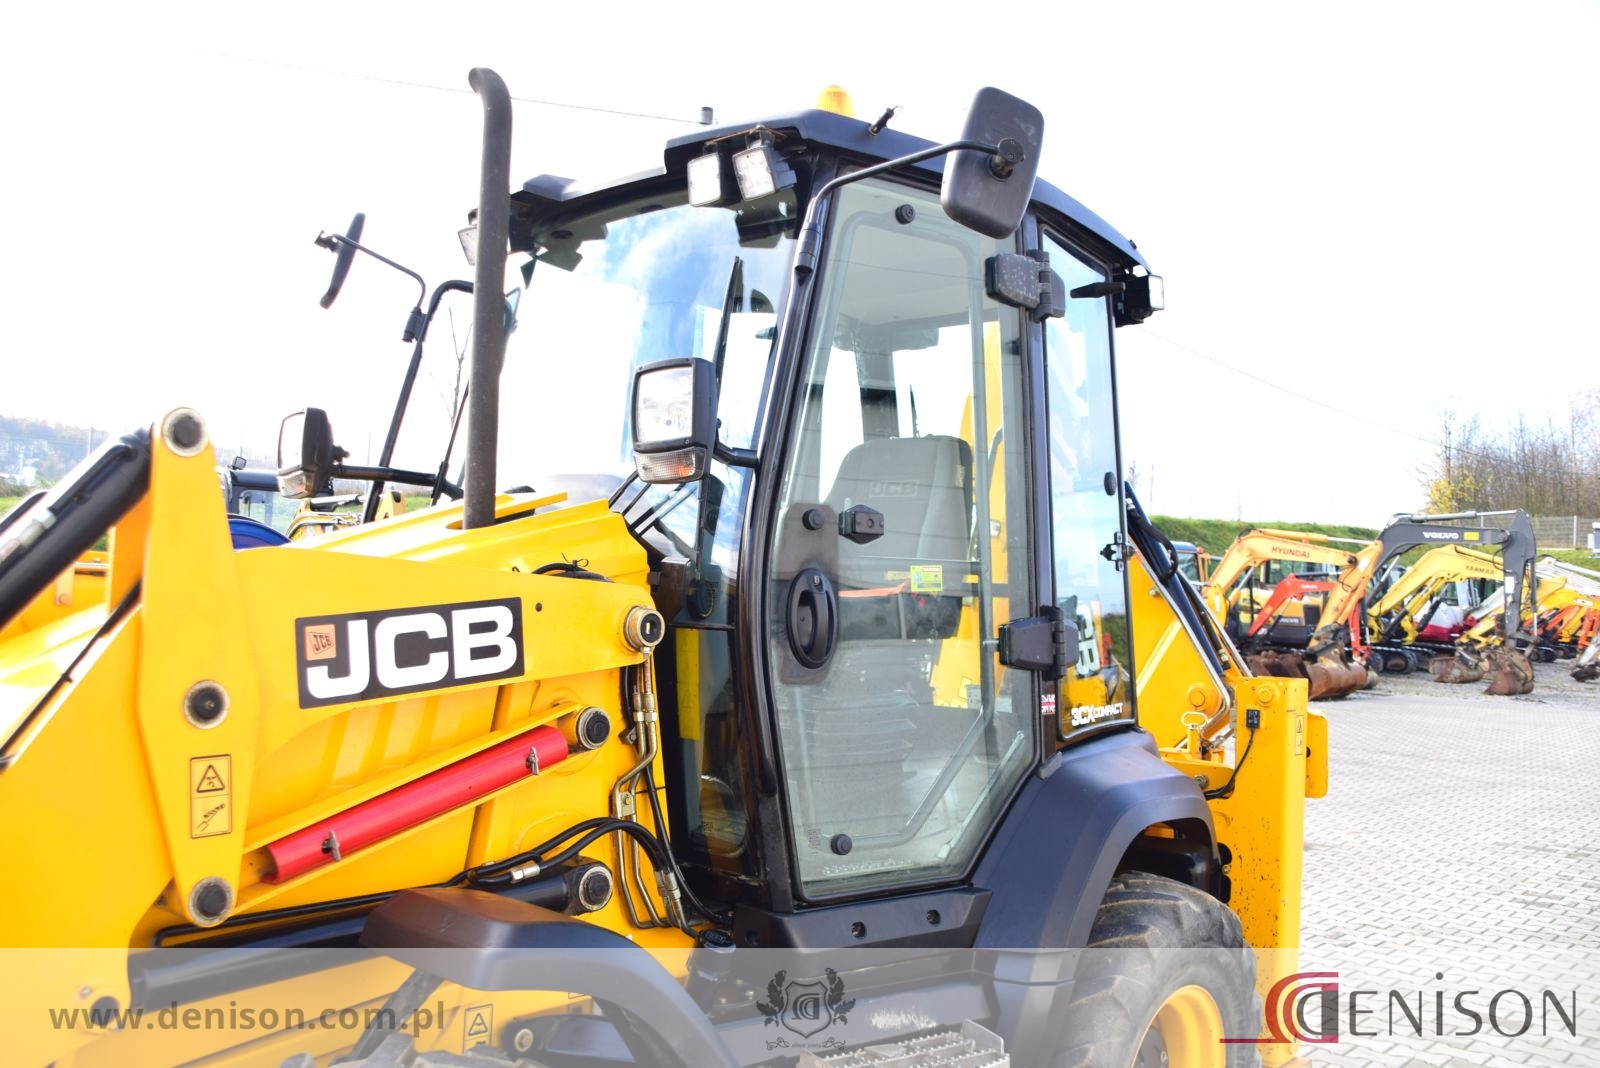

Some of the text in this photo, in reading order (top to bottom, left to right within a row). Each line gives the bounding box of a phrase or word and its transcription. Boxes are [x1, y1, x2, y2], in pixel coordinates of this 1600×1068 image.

[871, 481, 917, 497] JCB
[1422, 531, 1459, 540] VOLVO
[1272, 546, 1310, 559] HYUNDAI
[312, 634, 332, 652] JCB
[307, 606, 518, 699] JCB
[1071, 705, 1096, 727] 3CX
